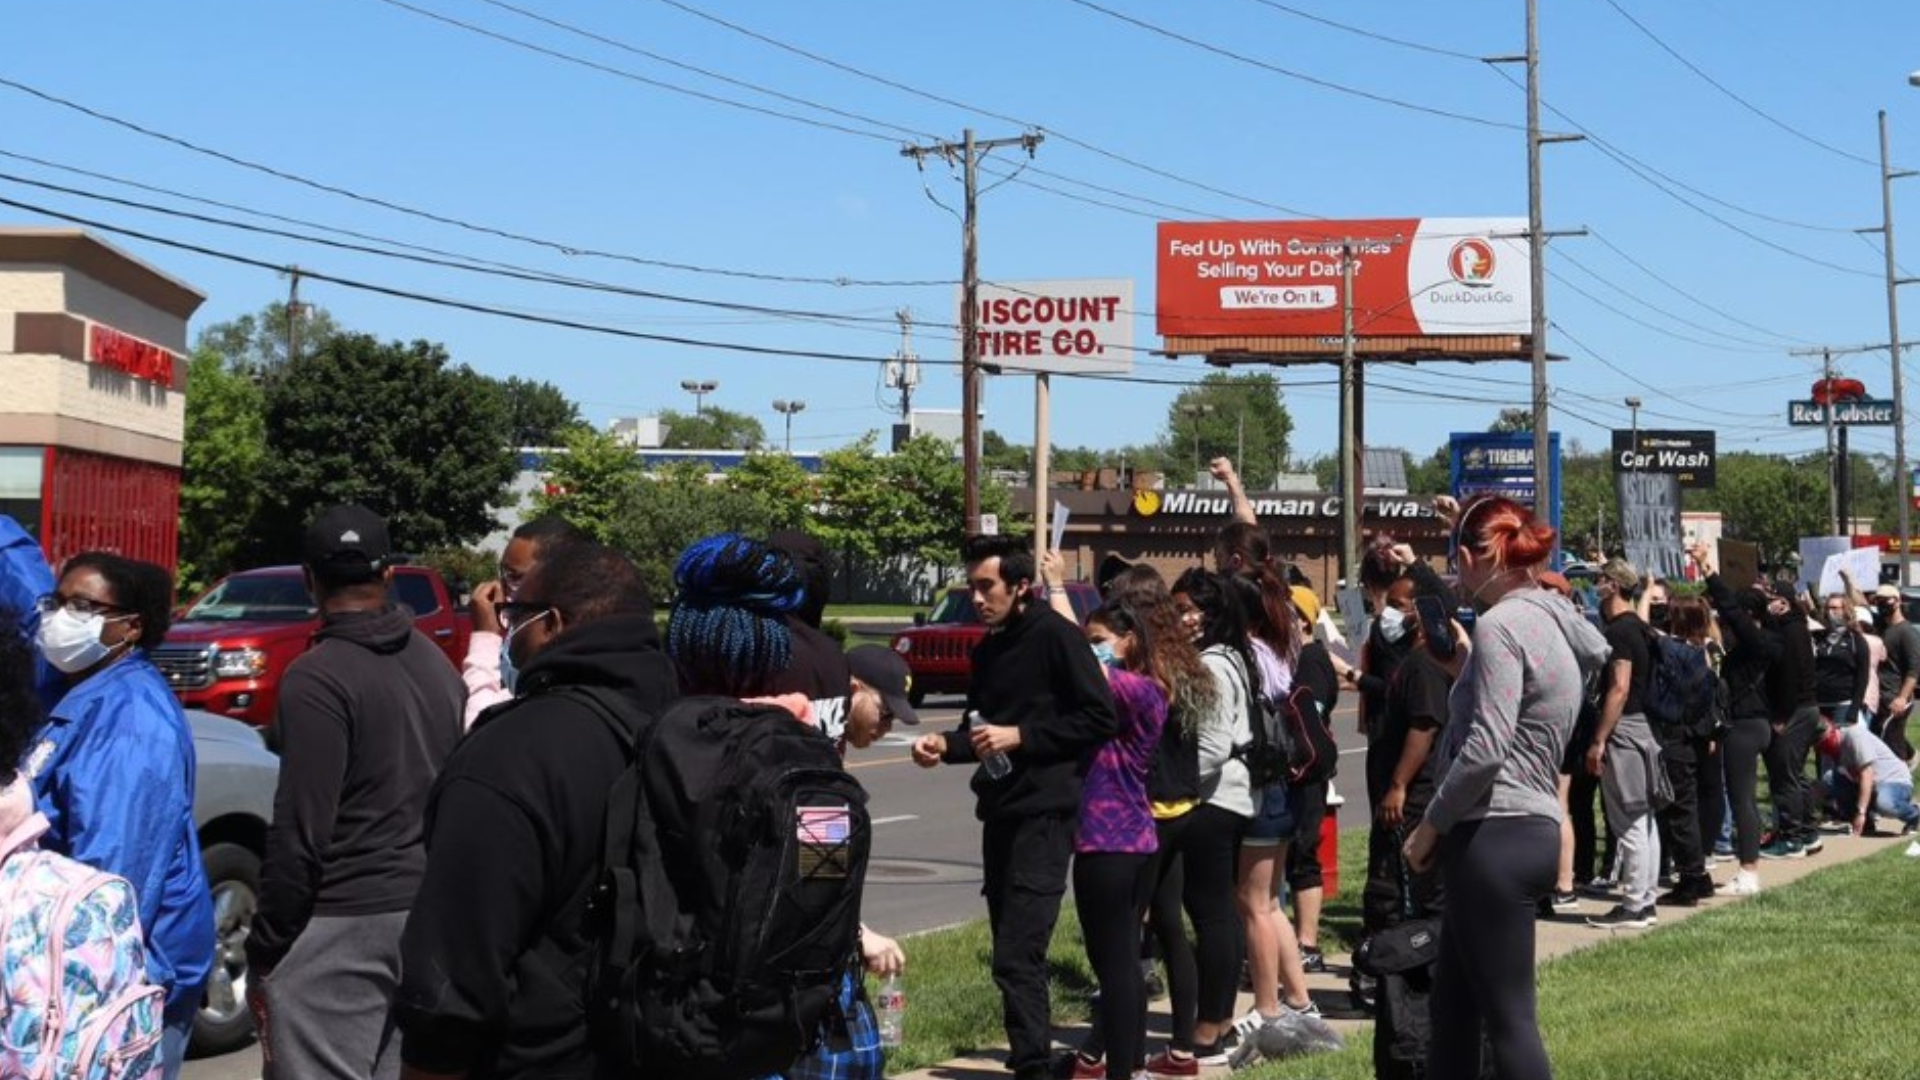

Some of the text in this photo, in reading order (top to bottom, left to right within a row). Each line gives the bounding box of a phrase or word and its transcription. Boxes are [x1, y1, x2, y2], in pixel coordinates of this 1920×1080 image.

[1170, 239, 1204, 256] Fed
[1208, 239, 1236, 260] Up
[1240, 239, 1282, 256] With
[1197, 261, 1362, 282] Selling Your Dat?
[1234, 289, 1280, 304] We're
[1283, 289, 1307, 304] On
[1430, 291, 1514, 304] DuckDuckGo
[976, 297, 1121, 325] ISCOUNT
[976, 328, 1105, 357] TIRE CO.
[1792, 403, 1892, 422] Red Lobster
[1488, 448, 1535, 465] TIREMA
[1620, 450, 1710, 469] Car Wash
[1162, 493, 1316, 517] Minuman
[1378, 500, 1440, 518] was
